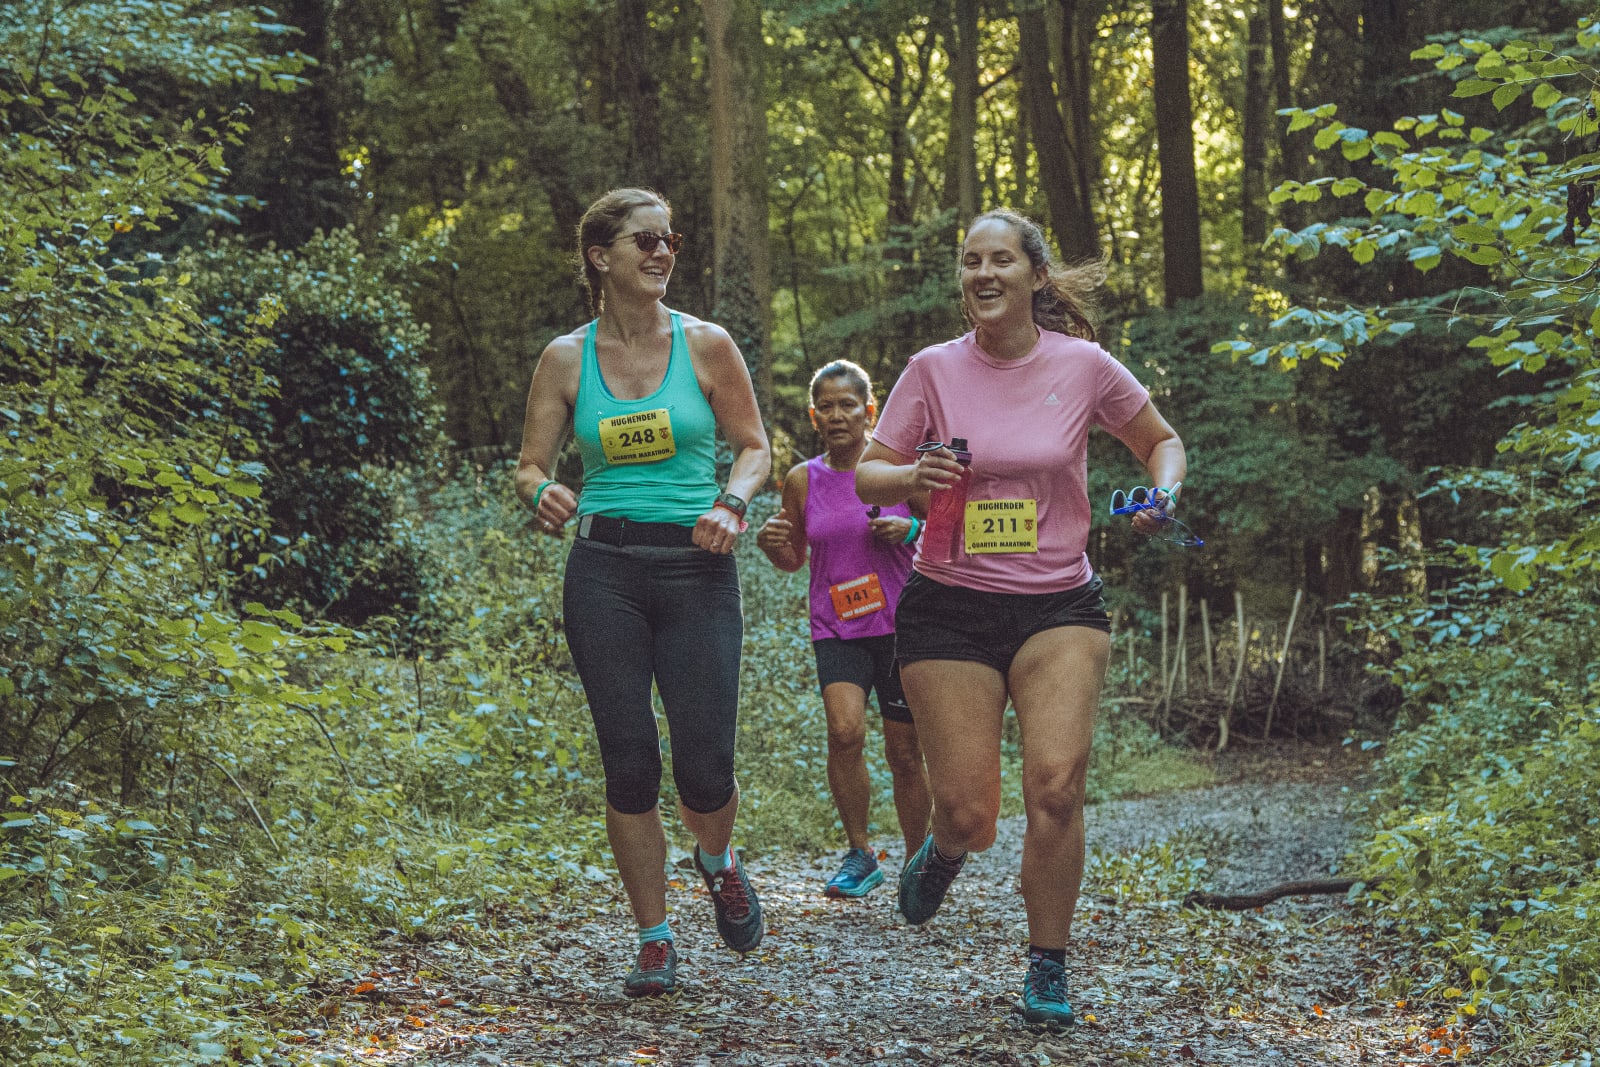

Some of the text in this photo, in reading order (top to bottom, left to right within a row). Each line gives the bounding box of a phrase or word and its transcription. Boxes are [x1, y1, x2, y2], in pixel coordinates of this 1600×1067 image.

[611, 412, 657, 427] HUGHENDEN
[618, 428, 656, 448] 248
[612, 447, 670, 461] QUARTER MARATHON
[977, 501, 1025, 511] HUGHENDEN
[982, 518, 1017, 534] 211
[971, 540, 1032, 549] QUARTER MARATHON
[845, 588, 869, 605] 141
